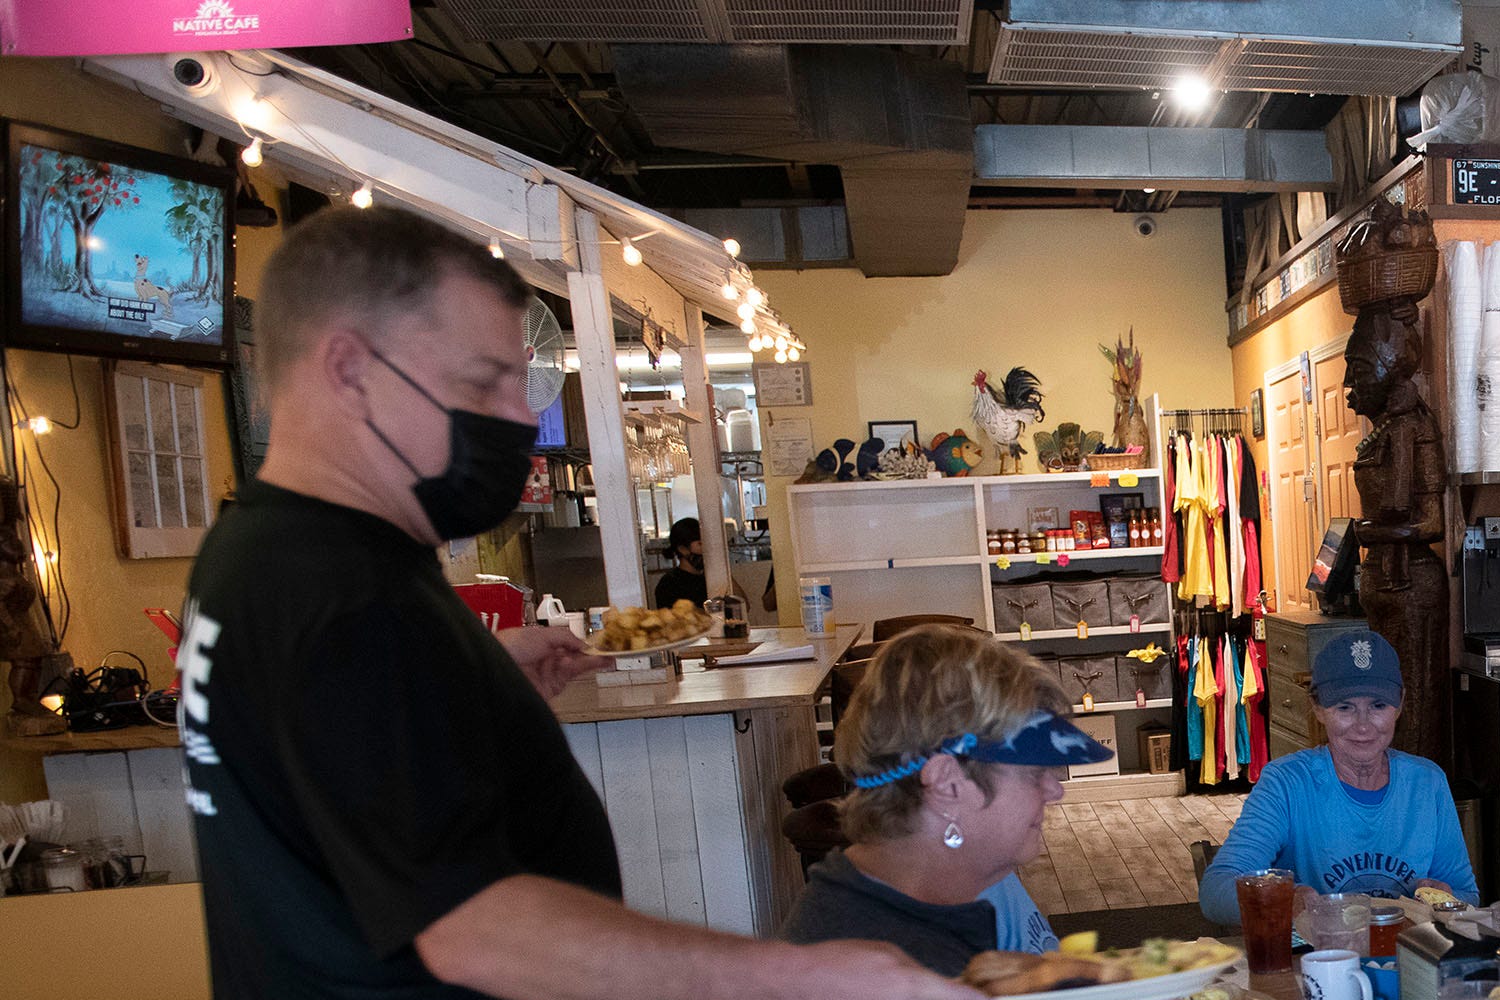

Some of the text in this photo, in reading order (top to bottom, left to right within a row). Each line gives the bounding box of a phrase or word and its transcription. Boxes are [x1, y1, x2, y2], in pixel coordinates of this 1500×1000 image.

[172, 17, 259, 33] NATIVE CAFE
[1458, 170, 1479, 194] 9E
[1323, 851, 1417, 889] ADVENTURE
